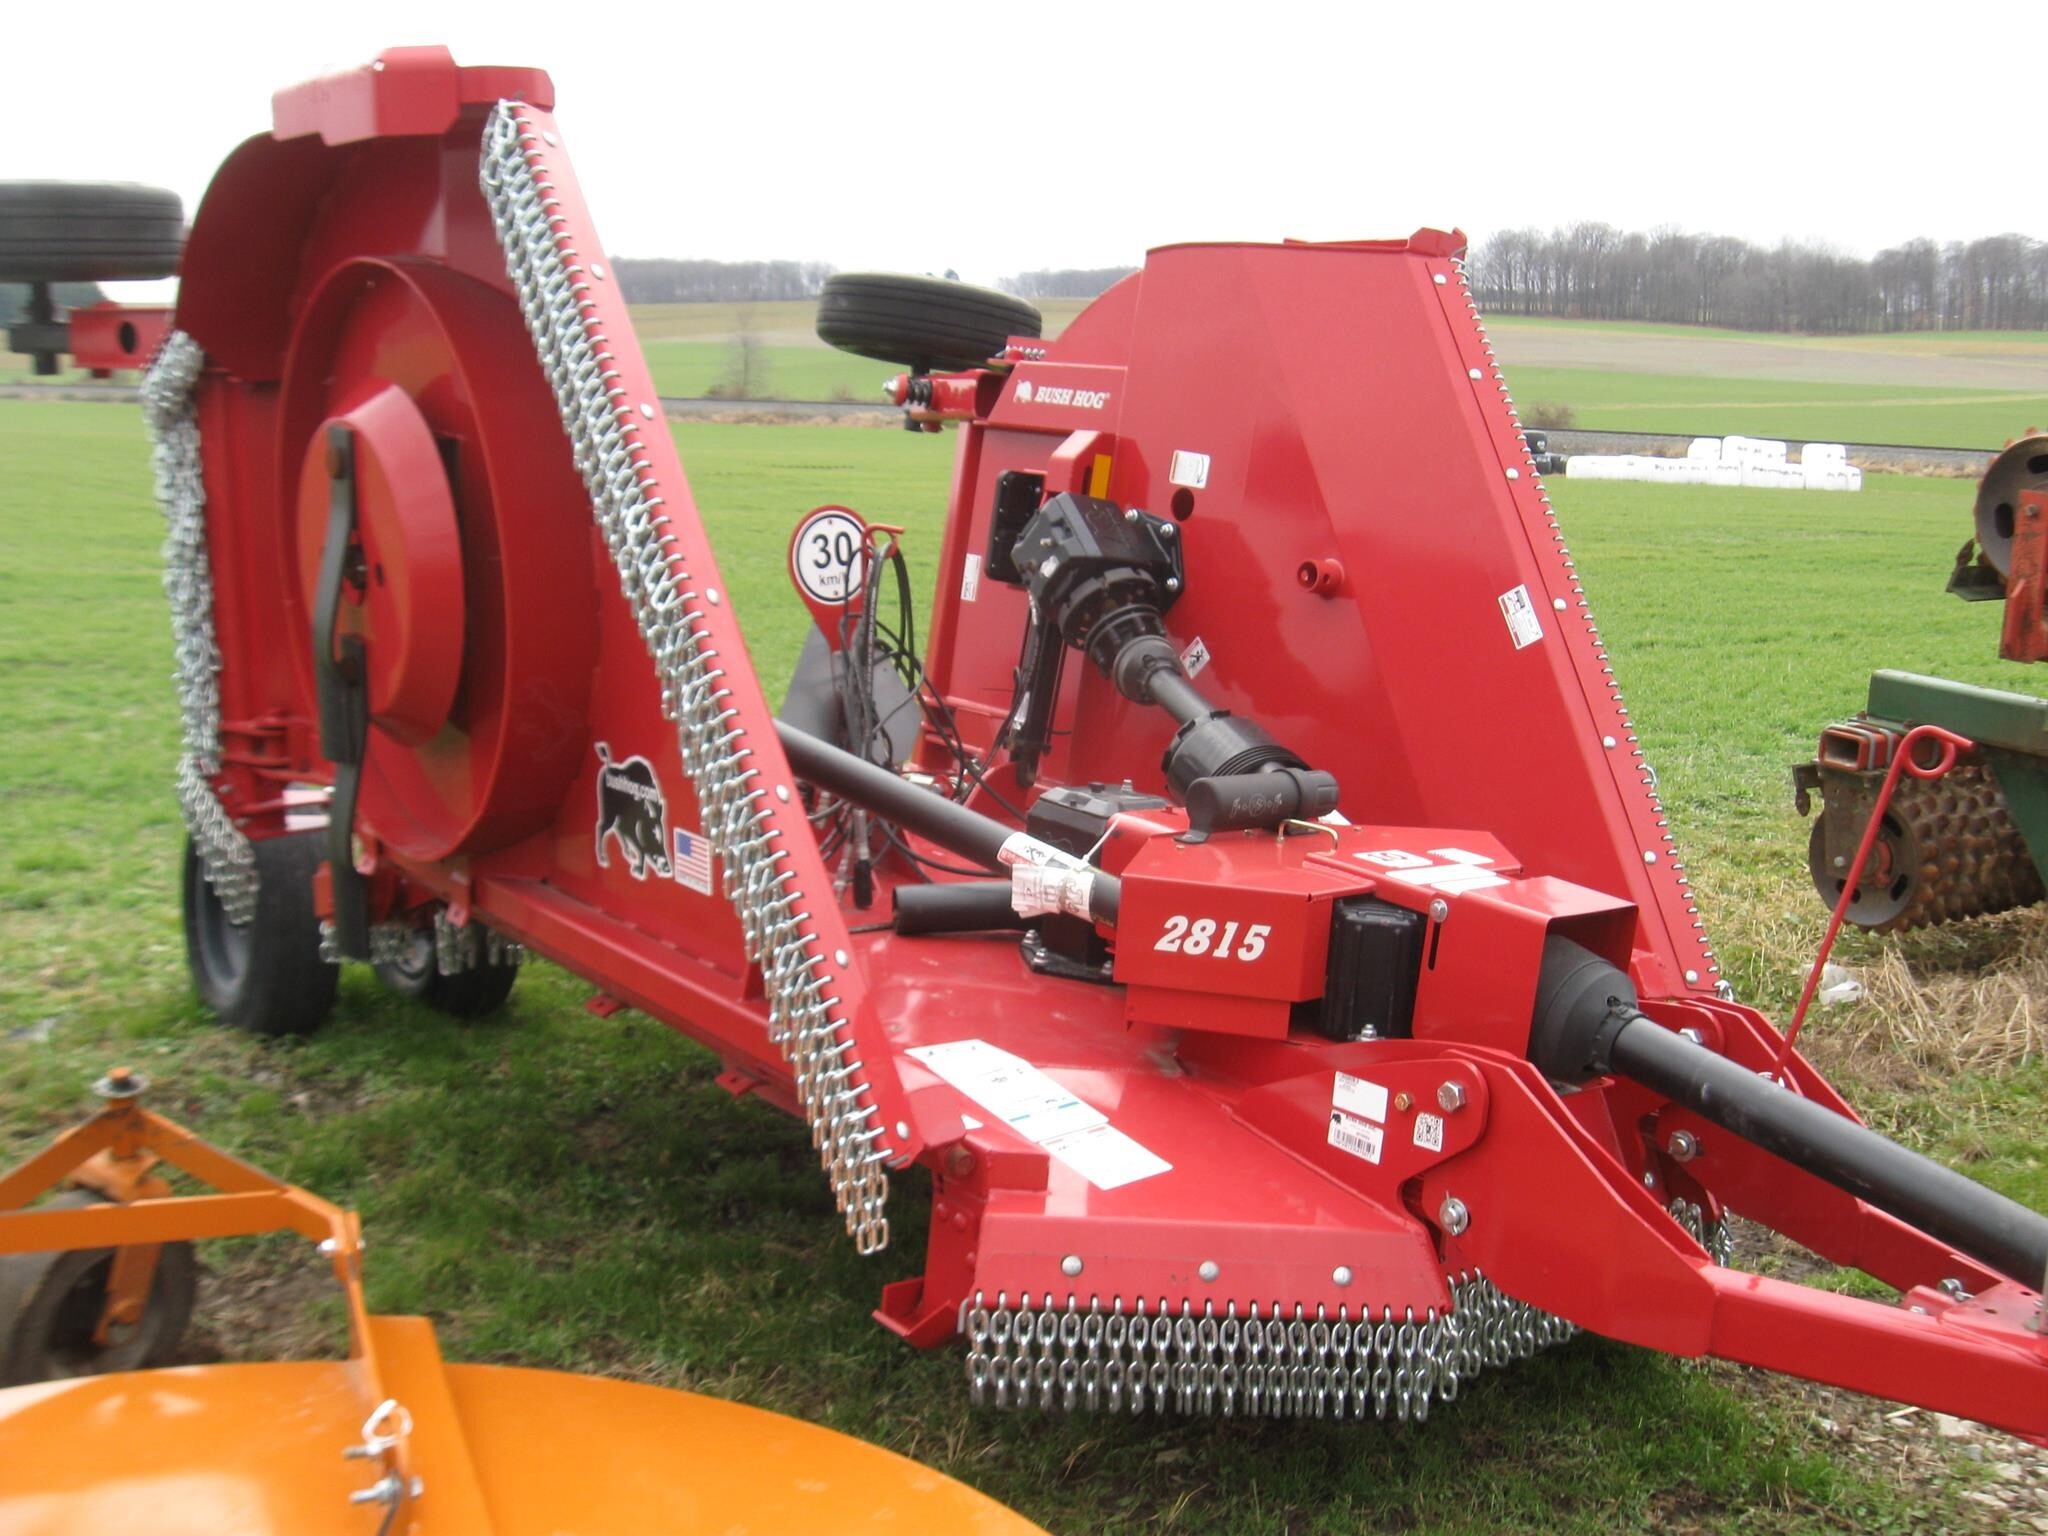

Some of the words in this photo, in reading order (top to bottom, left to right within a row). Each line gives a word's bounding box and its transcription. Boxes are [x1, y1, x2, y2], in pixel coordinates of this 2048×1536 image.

[1034, 385, 1074, 405] BUSH
[1071, 389, 1106, 409] HOG
[812, 531, 852, 569] 30
[819, 571, 848, 586] km/
[1153, 915, 1272, 962] 2815
